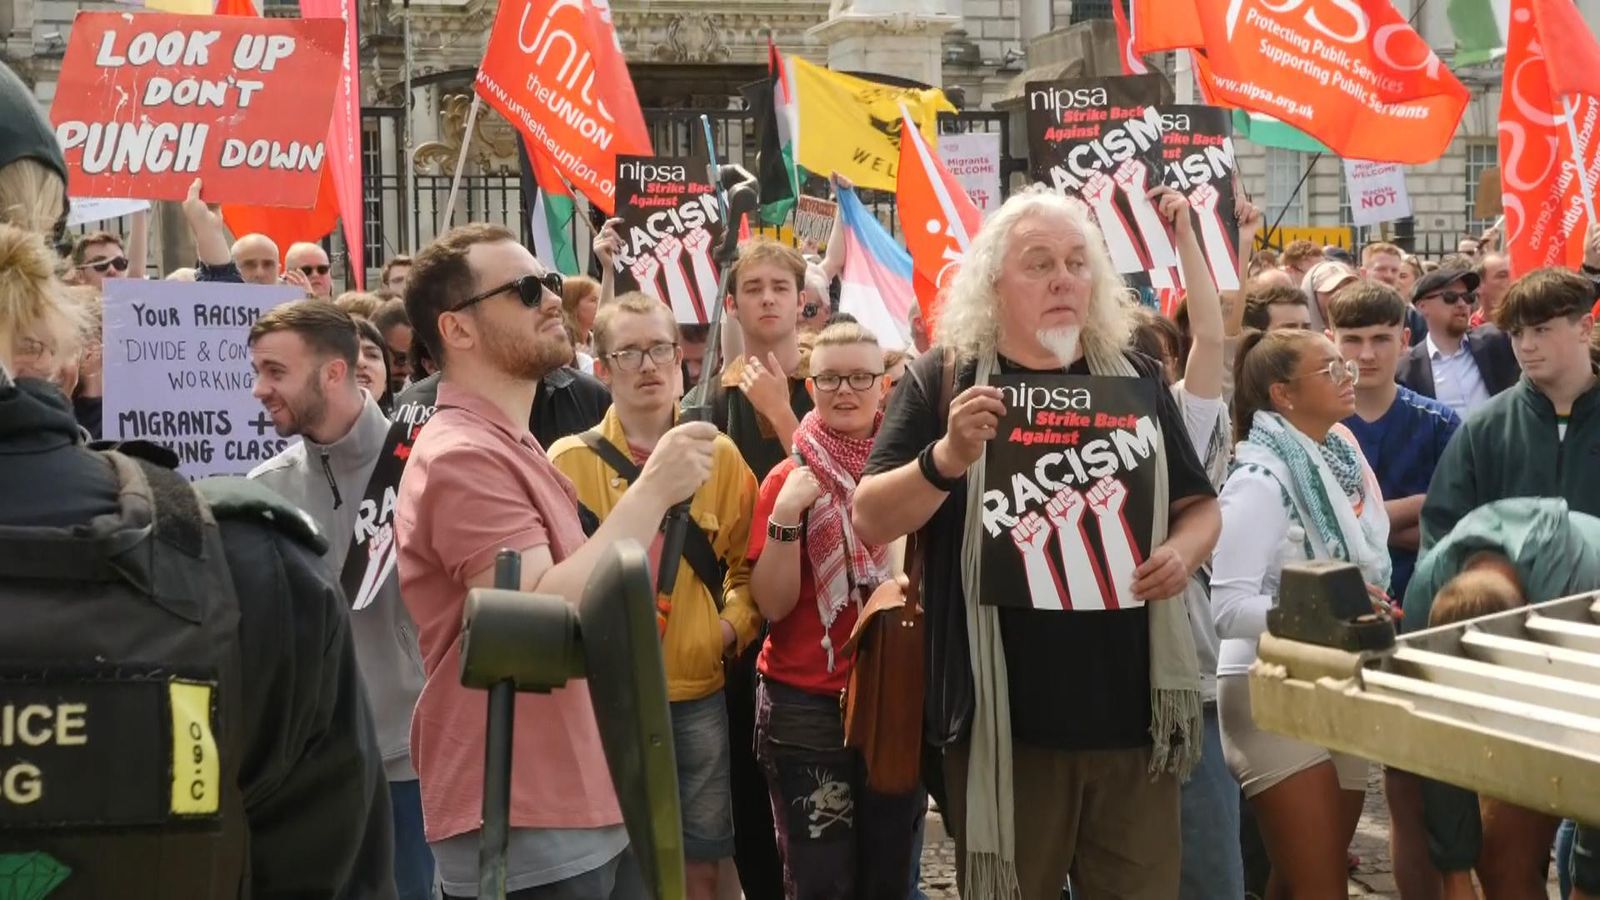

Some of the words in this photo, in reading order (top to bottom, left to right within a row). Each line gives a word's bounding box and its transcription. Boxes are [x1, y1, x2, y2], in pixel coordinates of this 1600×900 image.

[97, 30, 221, 67] LOOK
[234, 35, 296, 71] UP
[1246, 8, 1310, 52] Protecting
[1312, 40, 1350, 69] Public
[1352, 59, 1404, 93] Services
[143, 75, 264, 107] DON'T
[1259, 39, 1329, 85] Supporting
[1332, 73, 1367, 103] Public
[1368, 94, 1430, 119] Servants
[1031, 87, 1108, 124] nipsa
[1063, 107, 1107, 123] Strike
[1110, 105, 1145, 119] Back
[476, 70, 616, 198] www.unitetheunion.or
[1044, 124, 1101, 142] Against
[1162, 132, 1190, 145] rike
[1192, 132, 1225, 146] Back
[56, 121, 209, 173] PUNCH
[221, 139, 324, 171] DOWN
[1050, 105, 1163, 197] ACISM
[948, 157, 989, 167] Migrants
[1352, 166, 1396, 179] WELCOME
[620, 161, 686, 193] nipsa
[646, 183, 686, 194] Strike
[629, 194, 679, 208] Against
[1361, 191, 1397, 208] NOT
[132, 303, 180, 327] YOUR
[194, 304, 261, 327] RACISM
[197, 341, 210, 362] &
[168, 371, 254, 391] WORKING
[997, 383, 1092, 425] nipsa
[119, 411, 232, 438] MIGRANTS
[395, 401, 437, 439] nips
[1035, 411, 1091, 427] Strike
[1094, 412, 1138, 429] Back
[1009, 427, 1080, 446] Against
[982, 415, 1158, 539] RACISM
[2, 702, 88, 746] ICE
